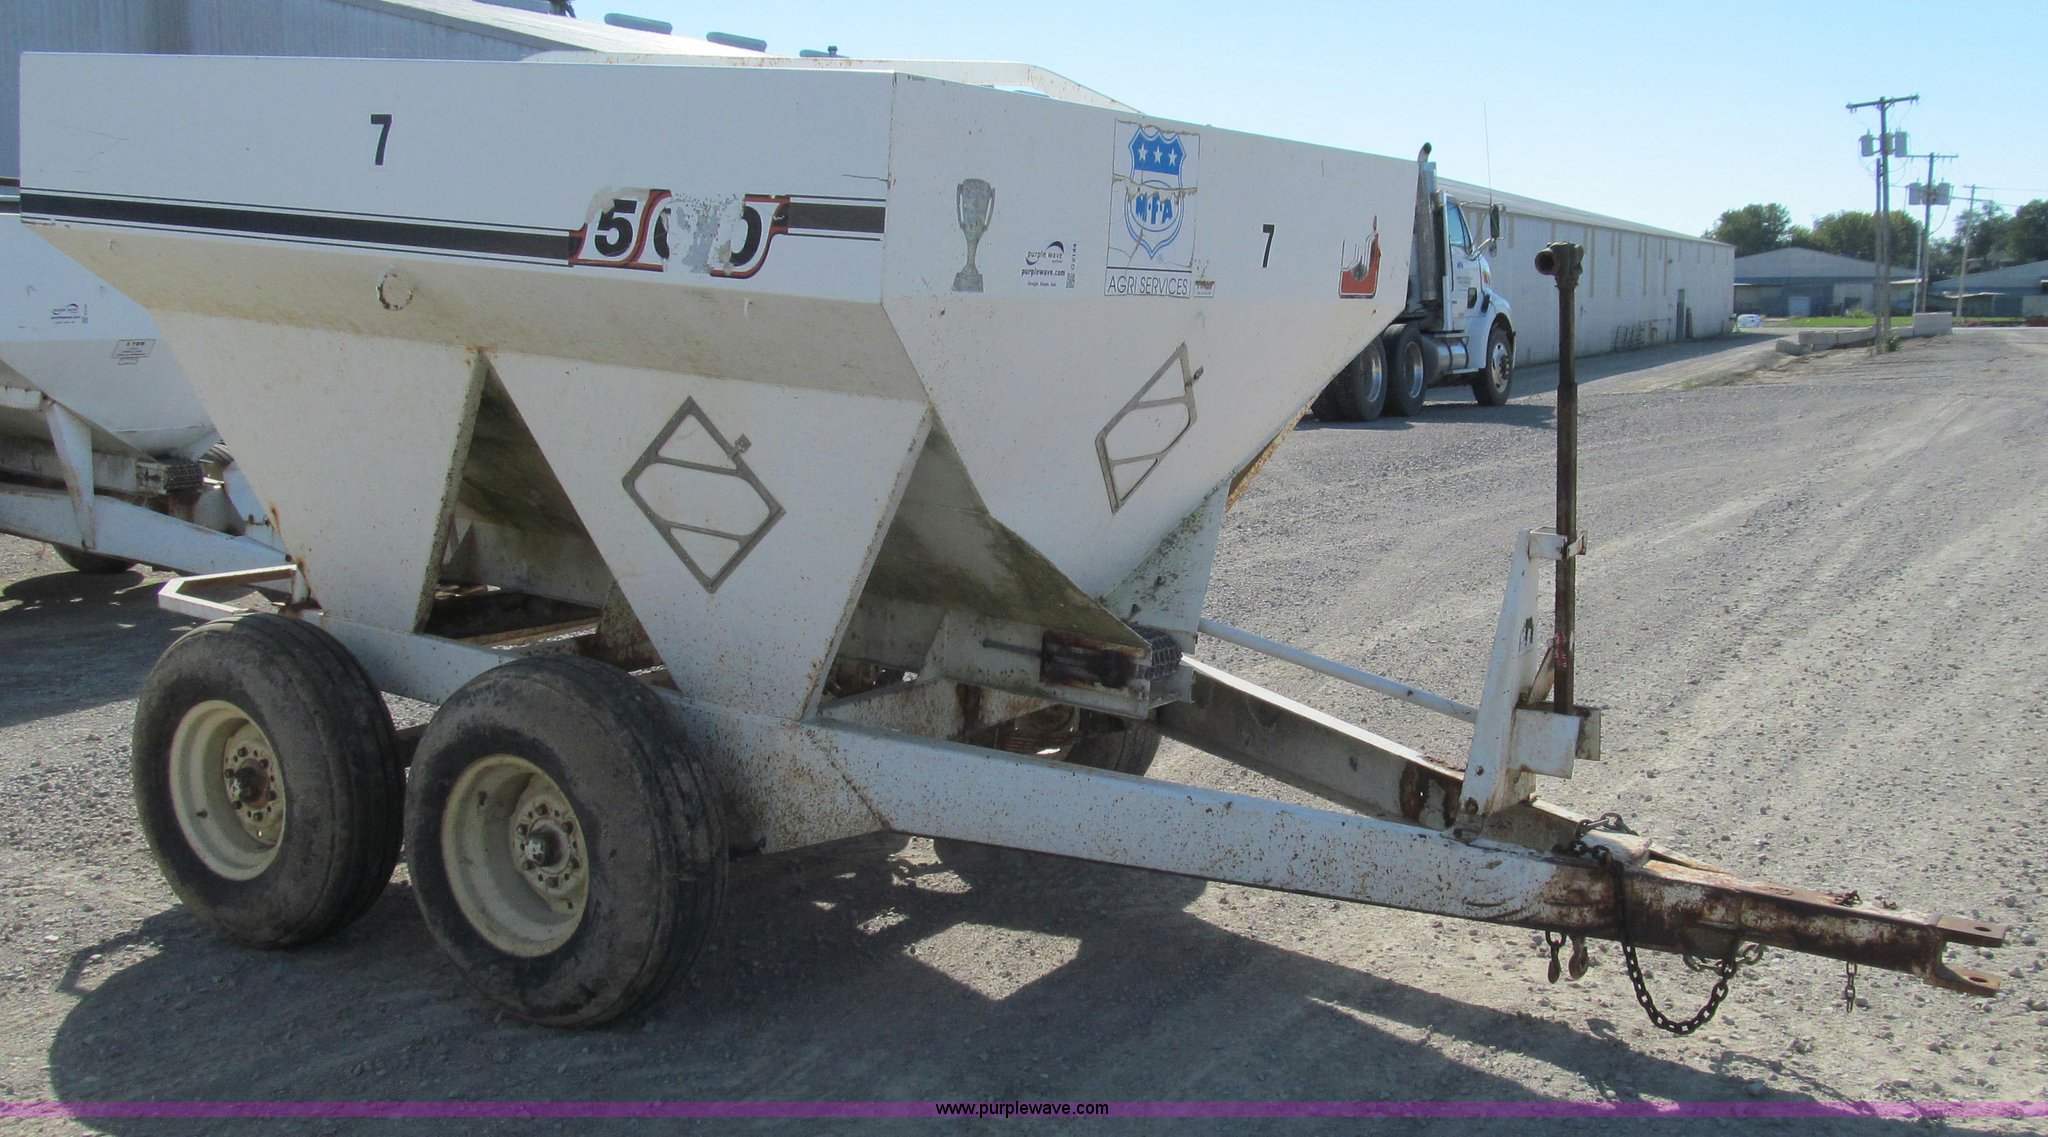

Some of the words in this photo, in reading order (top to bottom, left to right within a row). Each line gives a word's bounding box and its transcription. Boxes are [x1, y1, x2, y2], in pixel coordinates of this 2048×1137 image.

[370, 113, 392, 166] 7
[1262, 223, 1275, 268] 7
[1107, 275, 1137, 294] AGRI
[1139, 276, 1188, 295] SERVICES
